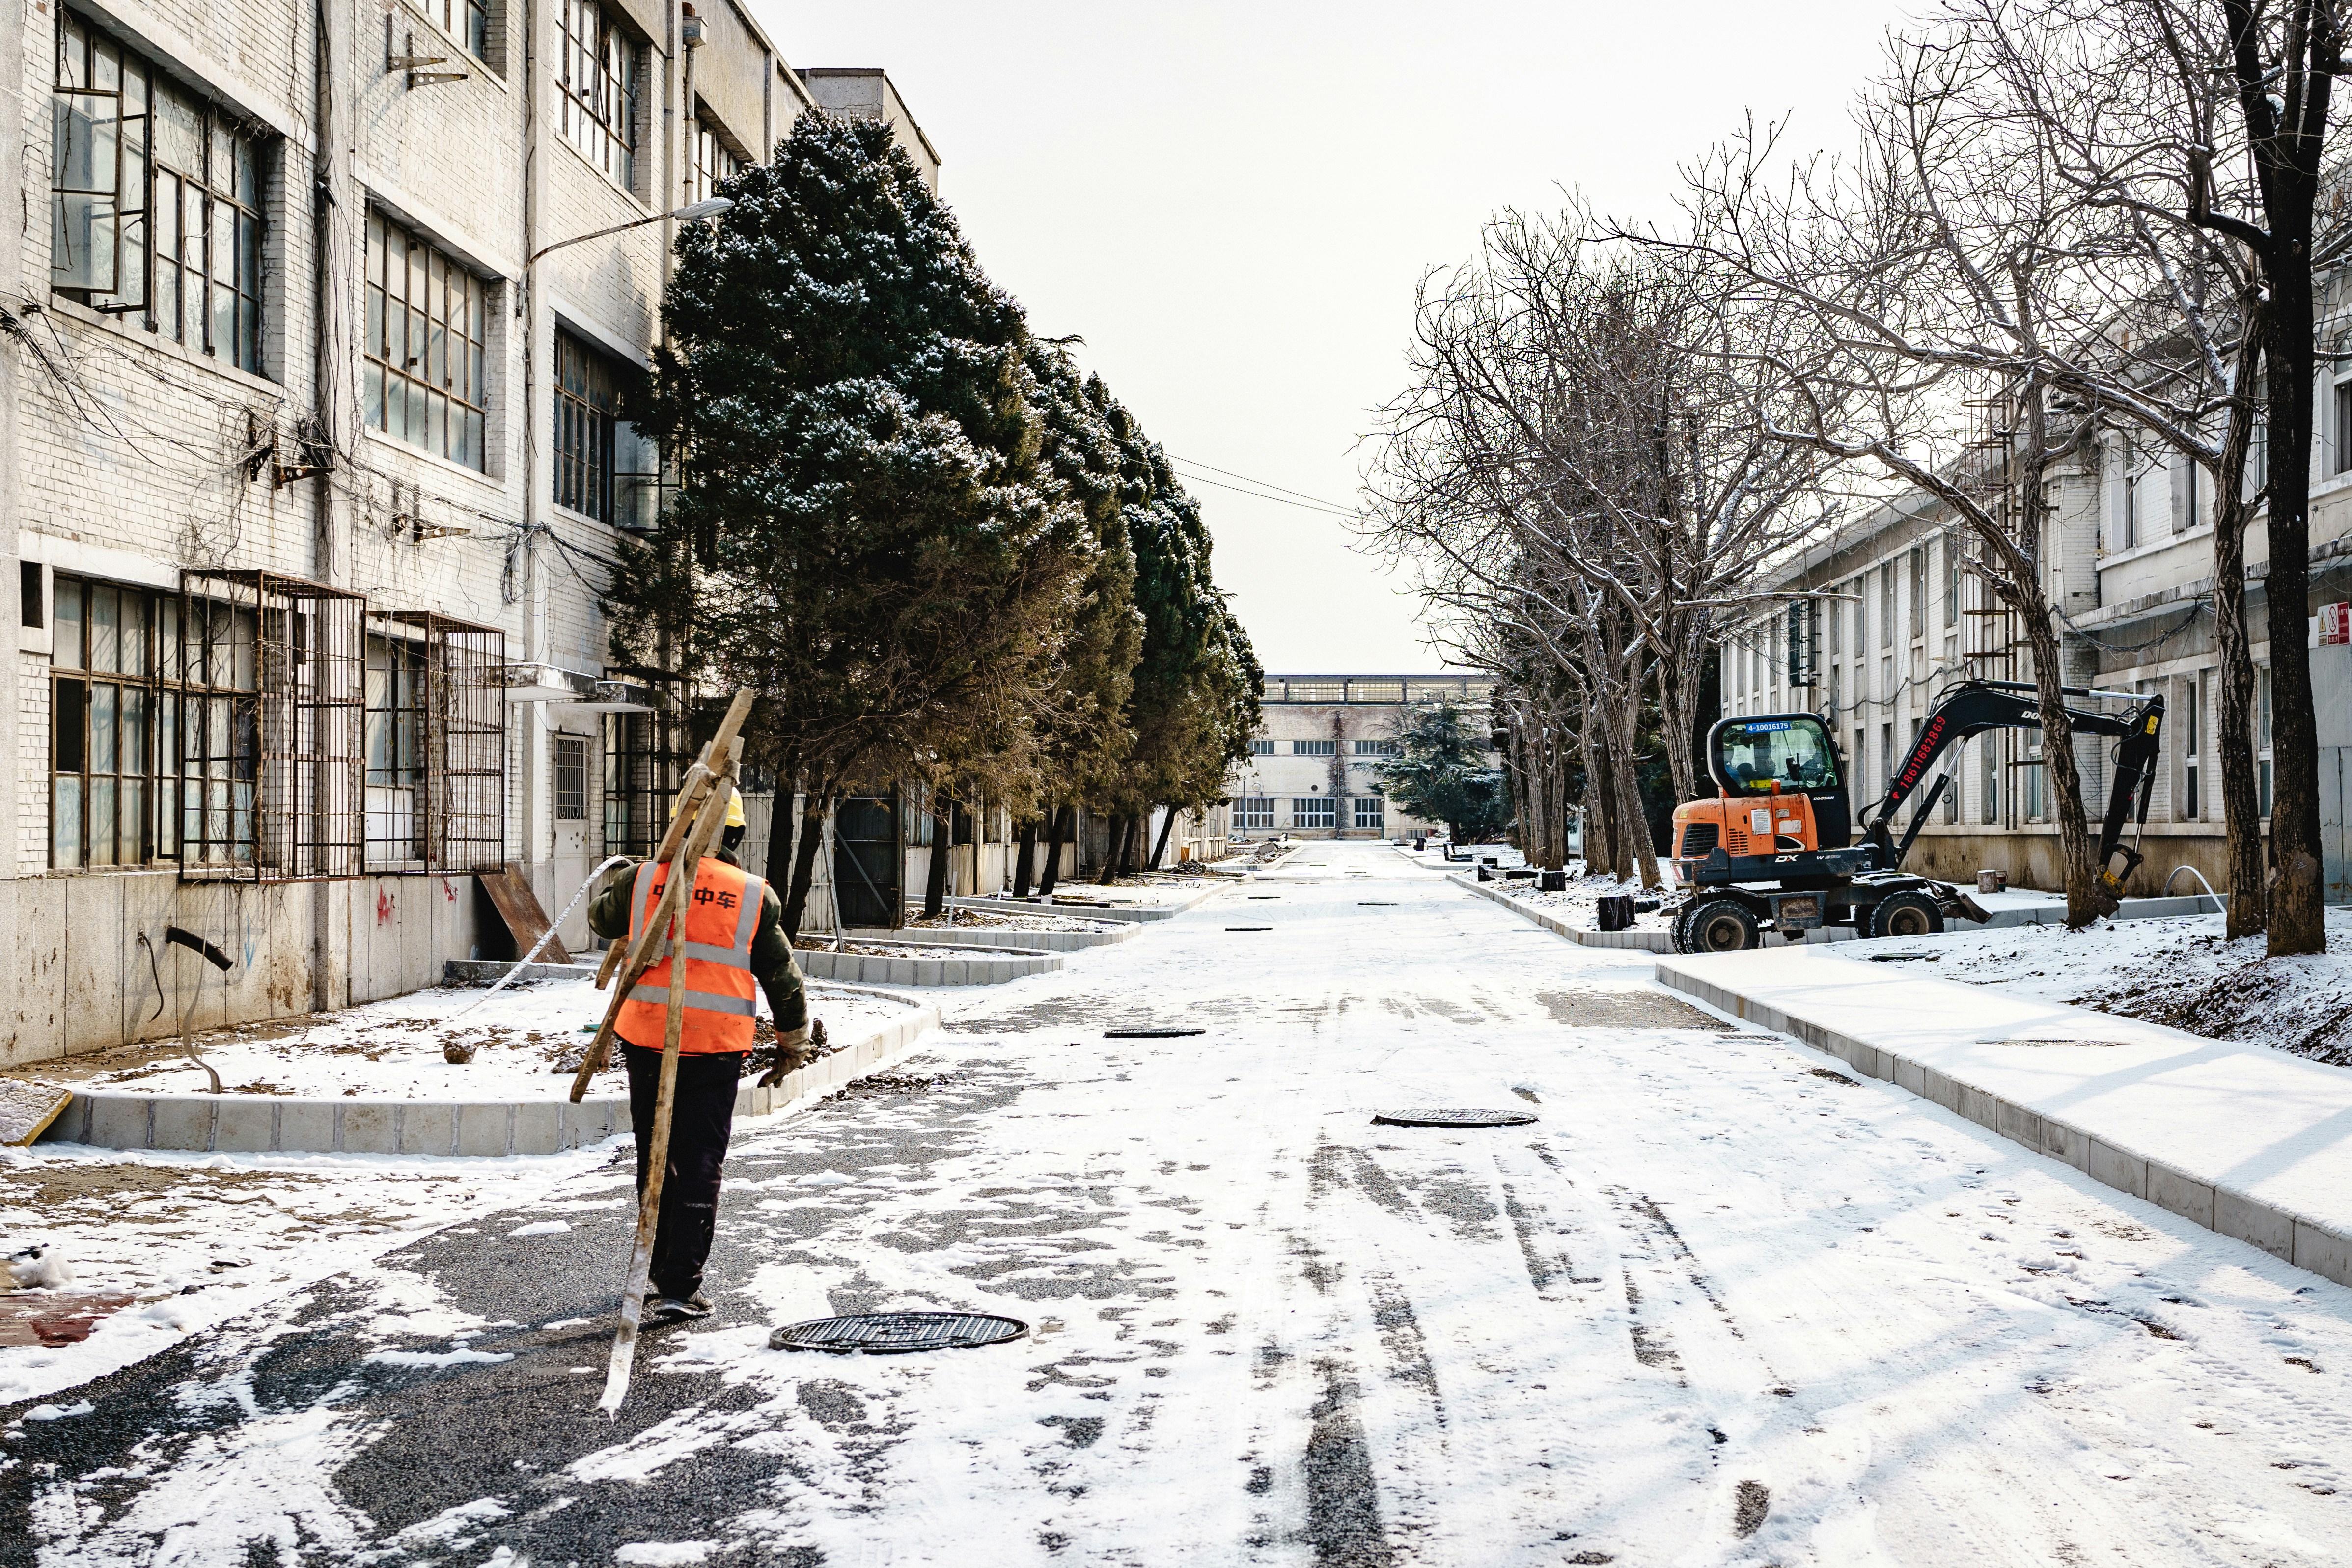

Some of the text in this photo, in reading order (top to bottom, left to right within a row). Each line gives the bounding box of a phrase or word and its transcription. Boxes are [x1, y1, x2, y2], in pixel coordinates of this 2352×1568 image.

[1748, 722, 1789, 732] 4-10016179
[1900, 716, 1946, 789] 18611682869
[1774, 854, 1799, 863] DX
[653, 883, 737, 909] 中中车
